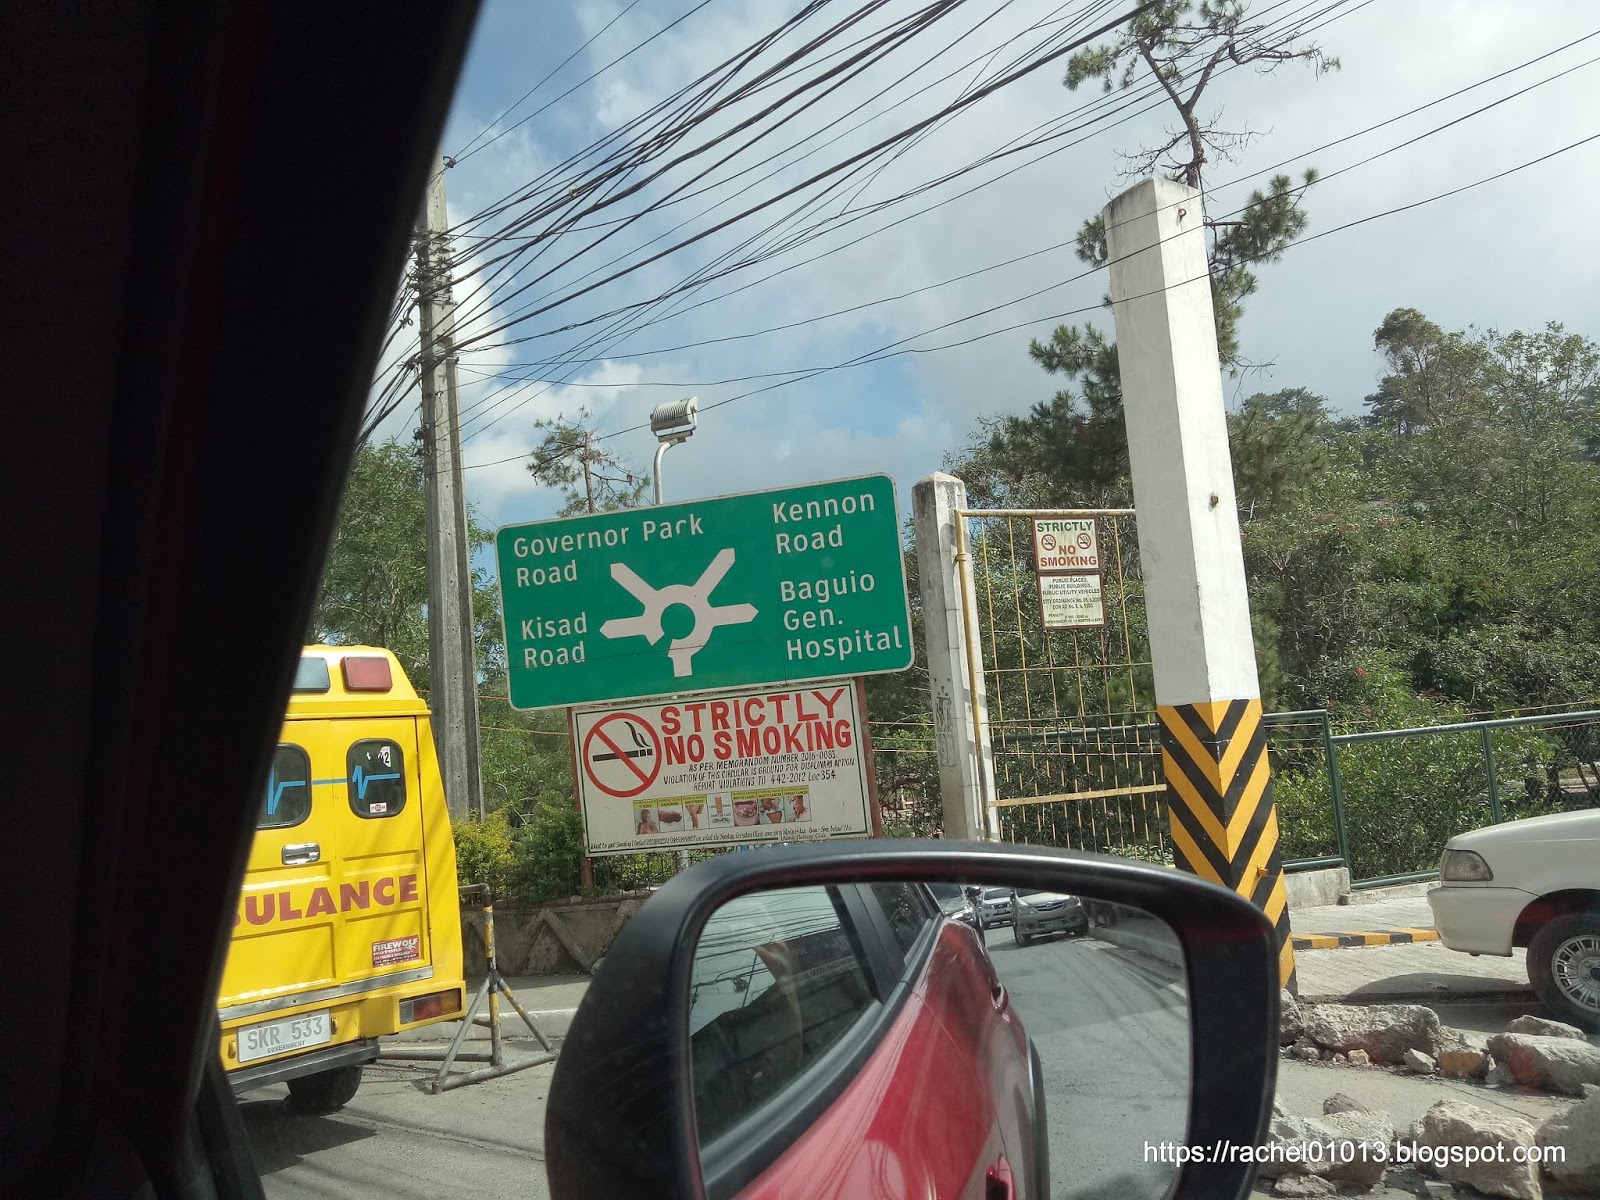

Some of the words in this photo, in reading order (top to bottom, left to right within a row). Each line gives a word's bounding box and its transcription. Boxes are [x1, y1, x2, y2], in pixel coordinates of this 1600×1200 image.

[772, 492, 876, 524] Kennon
[513, 526, 630, 558] Governor
[642, 513, 704, 542] Park
[775, 524, 844, 555] Road
[1037, 521, 1093, 533] STRICTLY
[1040, 556, 1097, 567] SMOKING
[1058, 545, 1076, 555] NO
[515, 559, 579, 588] Road
[779, 569, 876, 604] Baguio
[520, 611, 589, 640] Kisad
[782, 607, 844, 631] Gen.
[523, 641, 587, 669] Road
[786, 625, 903, 661] Hospital
[660, 688, 846, 736] STRICTLY
[664, 734, 705, 766] NO
[713, 719, 853, 760] SMOKING
[663, 773, 697, 785] VIOLATION
[698, 772, 706, 782] OF
[758, 764, 783, 775] GROUND
[785, 763, 799, 771] FOR
[689, 763, 697, 773] AS
[699, 762, 714, 772] PER
[770, 753, 799, 765] NUMBER
[693, 780, 715, 791] REPORT
[718, 777, 755, 789] VIOLATIONS
[758, 775, 766, 786] TO
[770, 771, 806, 785] 442-2012
[233, 873, 419, 928] ULANCE
[373, 937, 418, 952] FIREWOLF
[247, 1025, 281, 1050] SKR
[291, 1016, 323, 1040] 533
[267, 1040, 306, 1054] GOVERNMENT
